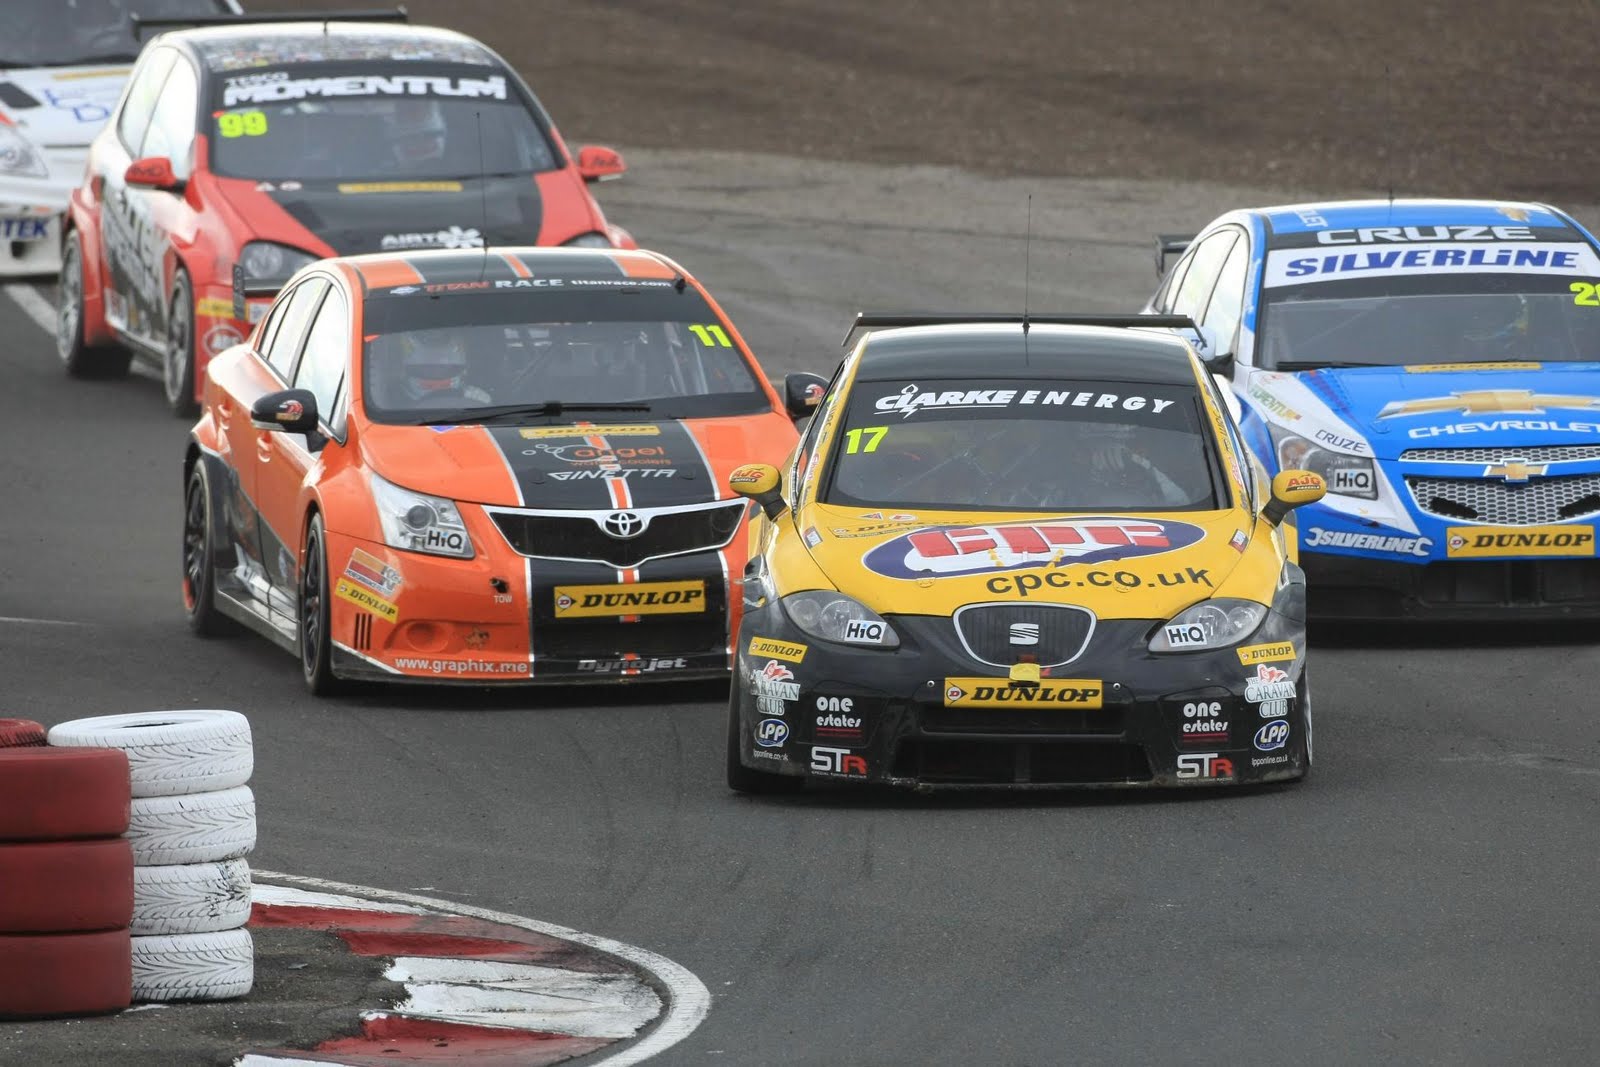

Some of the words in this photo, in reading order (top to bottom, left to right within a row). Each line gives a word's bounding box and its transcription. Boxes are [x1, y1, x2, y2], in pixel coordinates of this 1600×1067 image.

[223, 76, 506, 106] MOMENTUM
[219, 112, 268, 138] 99
[1316, 226, 1536, 245] CRUZE
[425, 281, 490, 294] TITAN
[495, 279, 565, 289] RACE
[570, 279, 673, 288] titanrace.com
[688, 323, 733, 348] 11
[874, 385, 1017, 416] CLARKE
[1019, 390, 1175, 414] ENERGY
[846, 425, 889, 454] 17
[1315, 429, 1367, 453] CRUZE
[575, 446, 665, 459] angel
[547, 468, 678, 481] GINETTA
[1336, 472, 1369, 488] HiQ
[427, 530, 463, 550] HiQ
[1472, 533, 1593, 547] DUNLOP
[986, 566, 1214, 597] cpc.co.uk
[349, 589, 396, 615] DUNLOP
[494, 595, 513, 604] TOW
[581, 590, 702, 608] DUNLOP
[847, 623, 882, 640] HiQ
[1168, 626, 1205, 643] HiQ
[759, 643, 803, 657] DUNLOP
[1251, 647, 1292, 659] DUNLOP
[395, 658, 528, 673] www.graphix.me
[577, 657, 688, 673] Dynojet
[971, 687, 1100, 702] DUNLOP
[1246, 682, 1297, 701] CARAVAN
[758, 697, 785, 715] CLUB
[816, 696, 853, 712] one
[1183, 702, 1222, 717] one
[1260, 700, 1288, 716] CLUB
[816, 714, 862, 728] estates
[1183, 720, 1228, 733] estates
[759, 722, 786, 741] LPP
[1260, 725, 1288, 743] LPP
[811, 746, 868, 775] STR
[1176, 753, 1233, 778] STR
